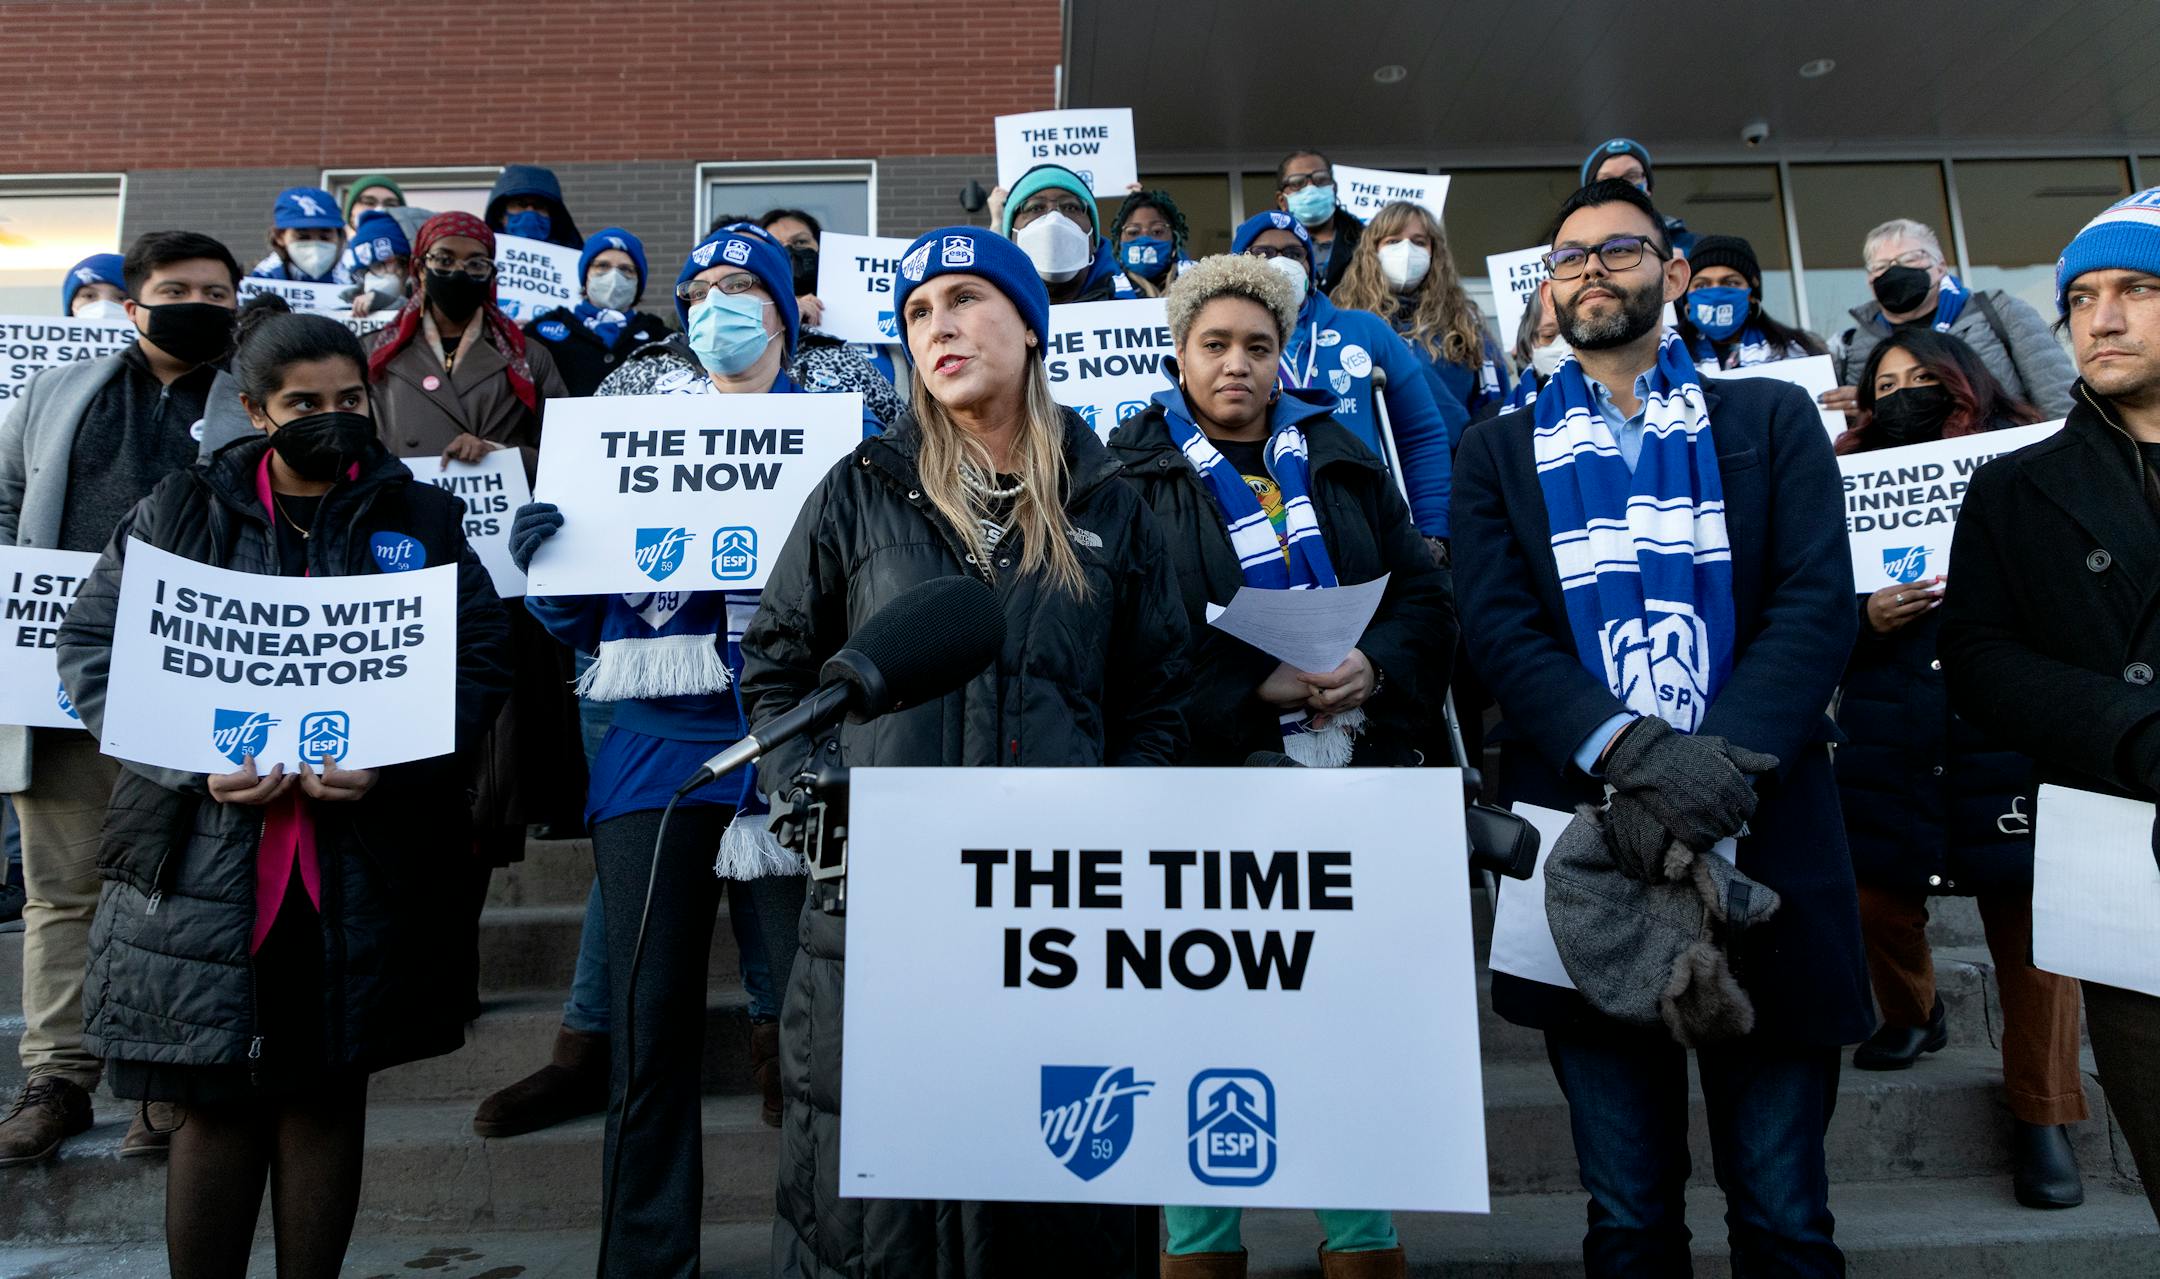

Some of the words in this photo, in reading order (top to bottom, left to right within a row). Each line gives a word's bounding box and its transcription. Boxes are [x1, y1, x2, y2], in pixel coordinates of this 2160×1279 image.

[1021, 127, 1058, 142] THE
[1063, 126, 1109, 140] TIME
[1032, 144, 1049, 158] IS
[1055, 142, 1100, 156] NOW
[1350, 182, 1382, 196] THE
[1386, 186, 1425, 199] TIME
[1354, 195, 1370, 207] IS
[505, 248, 556, 270] SAFE,
[949, 250, 968, 258] esp
[496, 261, 563, 285] STABLE
[1509, 267, 1514, 278] I
[496, 275, 570, 299] CHOOLS
[867, 277, 891, 293] IS
[1093, 326, 1174, 350] TIME
[1048, 360, 1070, 382] S
[1078, 353, 1160, 380] NOW
[600, 429, 686, 458] THE
[699, 428, 805, 456] TIME
[431, 472, 504, 494] WITH
[618, 464, 660, 494] IS
[672, 462, 784, 492] NOW
[1843, 463, 1945, 492] STAND
[376, 539, 414, 566] mft
[635, 527, 695, 575] mft
[722, 555, 748, 568] ESP
[1884, 545, 1935, 580] mft
[397, 562, 410, 571] 59
[660, 561, 673, 572] 59
[1907, 570, 1919, 578] 59
[12, 572, 23, 593] I
[155, 579, 166, 605] I
[175, 587, 311, 628] STAND
[321, 595, 423, 627] WITH
[657, 591, 679, 612] 59
[150, 609, 425, 657] MINNEAPOLIS
[162, 645, 409, 687] EDUCATORS
[212, 711, 282, 758] mft
[311, 739, 338, 752] ESP
[241, 745, 255, 756] 59
[960, 848, 1123, 910] THE
[1149, 850, 1354, 911] TIME
[1002, 926, 1079, 990] IS
[1105, 928, 1316, 991] NOW
[1041, 1065, 1154, 1166] mft
[1091, 1138, 1114, 1160] 59
[1210, 1131, 1256, 1157] ESP
